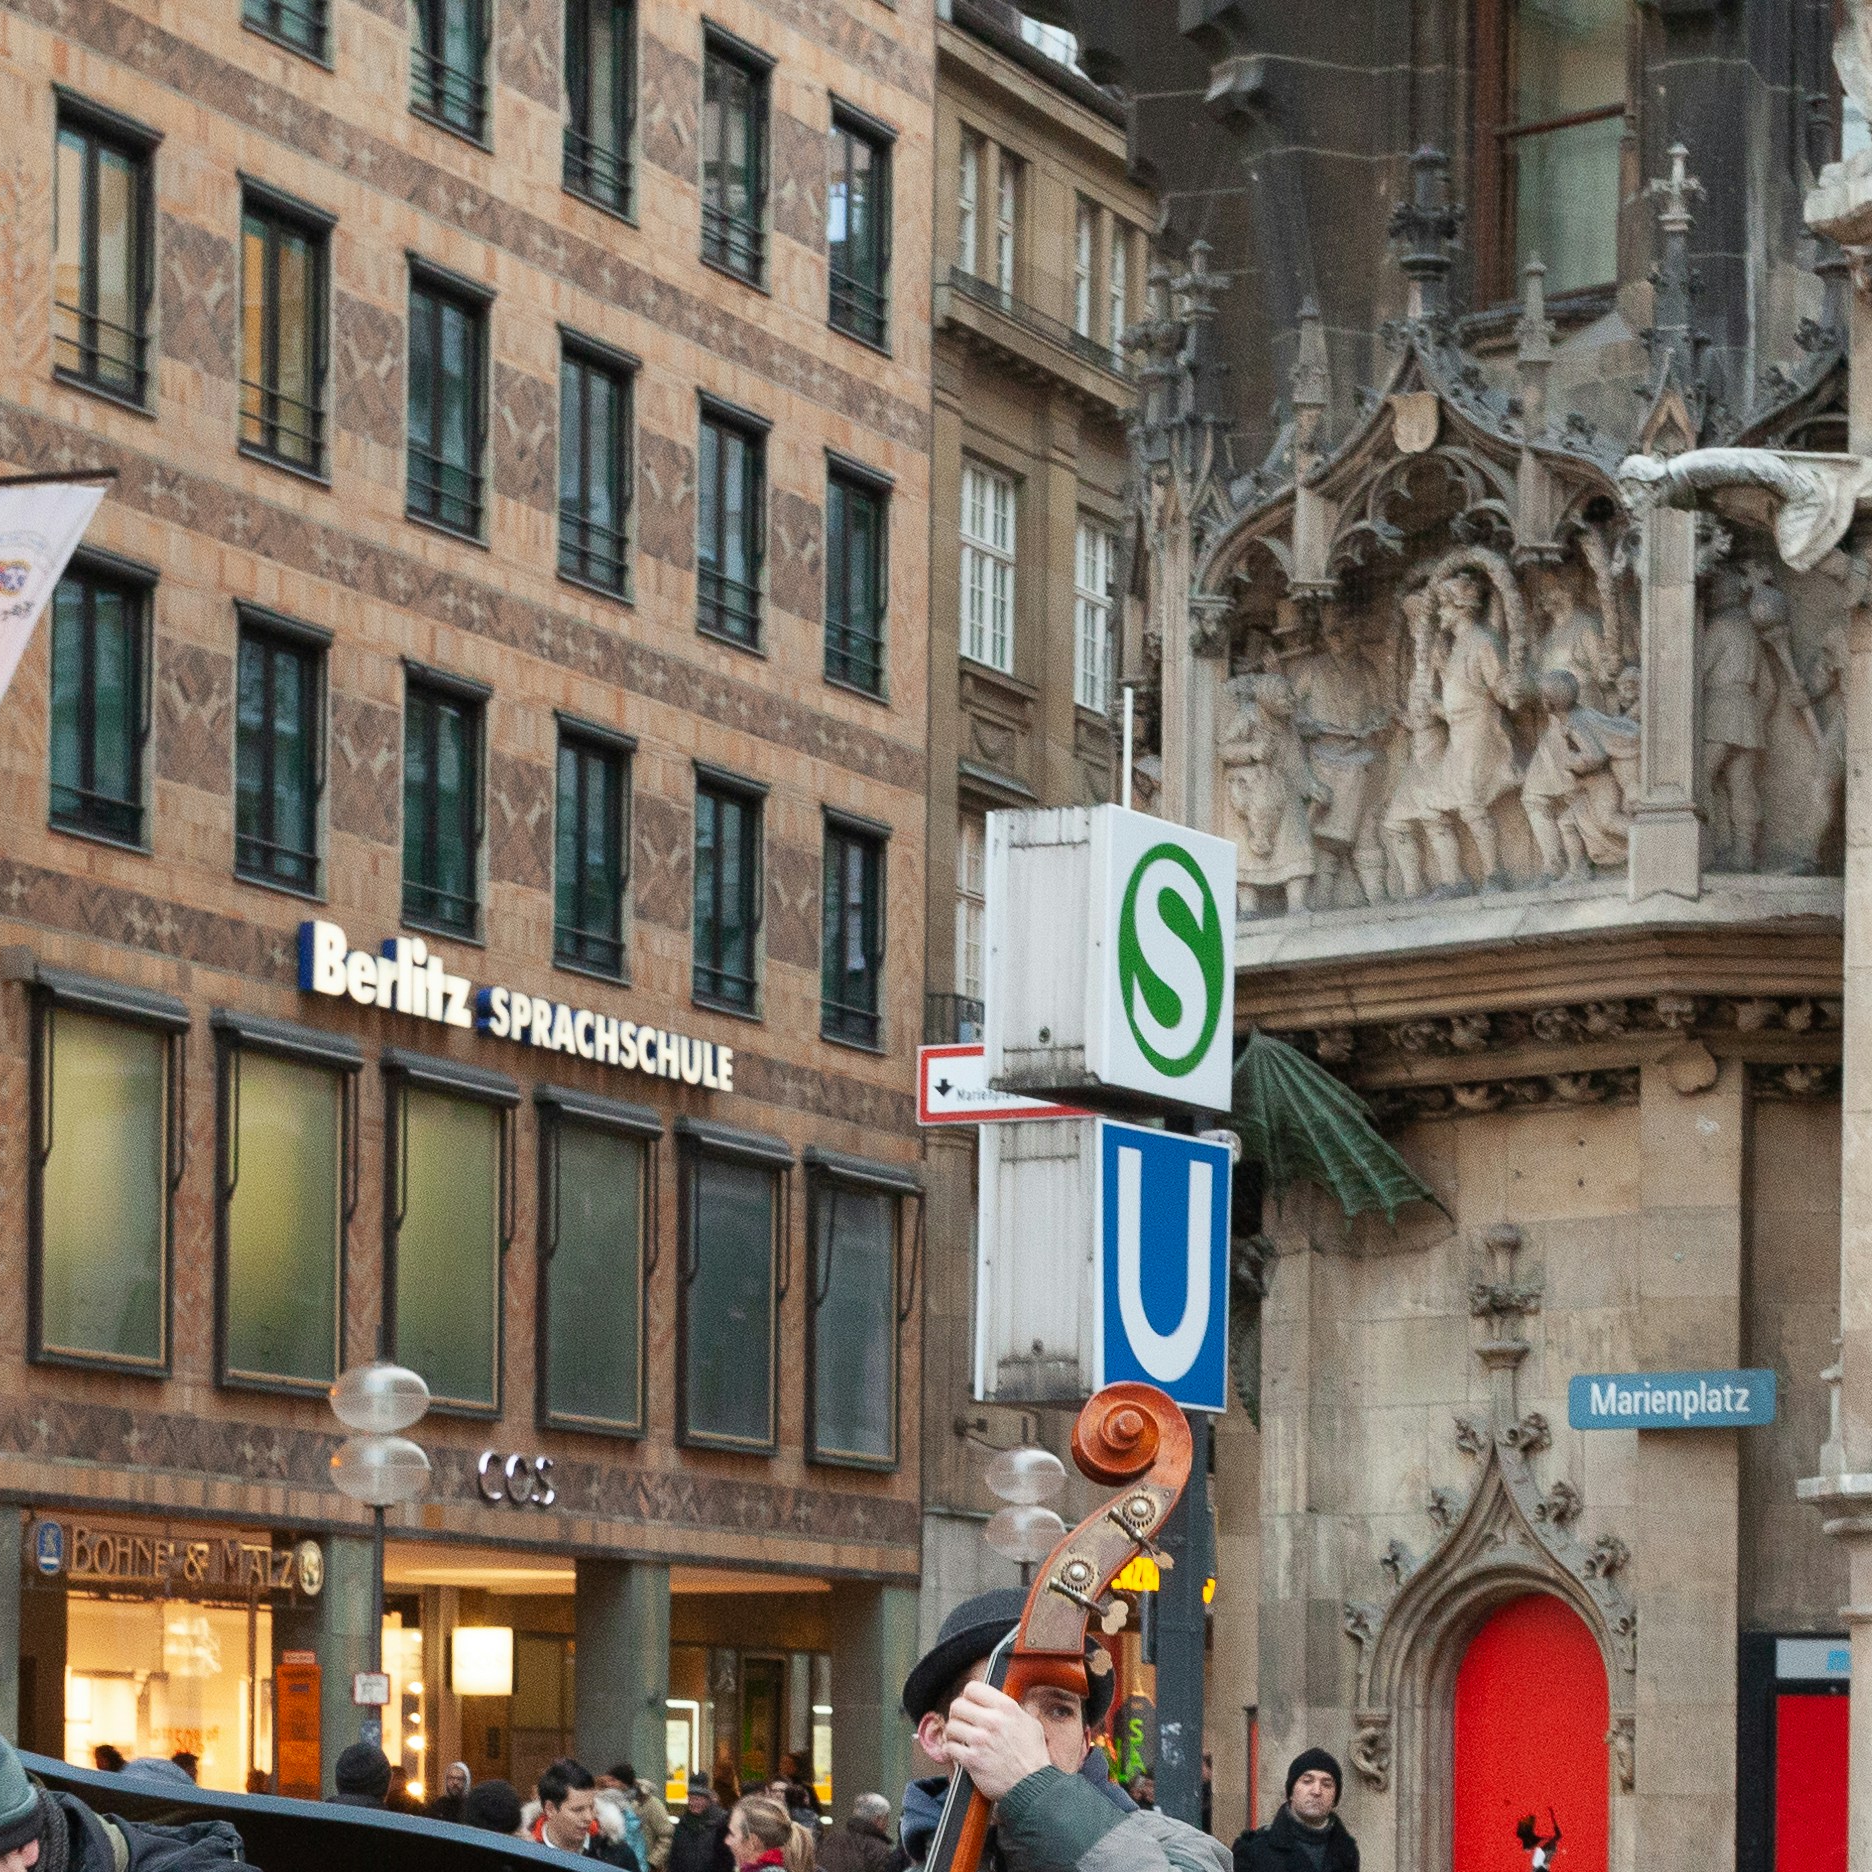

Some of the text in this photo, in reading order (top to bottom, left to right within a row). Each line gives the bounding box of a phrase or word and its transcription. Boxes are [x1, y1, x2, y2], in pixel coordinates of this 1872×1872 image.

[300, 918, 735, 1093] Berlitz SPRACHSCHULE
[1118, 1145, 1213, 1383] U
[1589, 1381, 1752, 1421] Marienplatz
[477, 1450, 556, 1506] COS
[71, 1524, 295, 1588] BOHNE & MALZ
